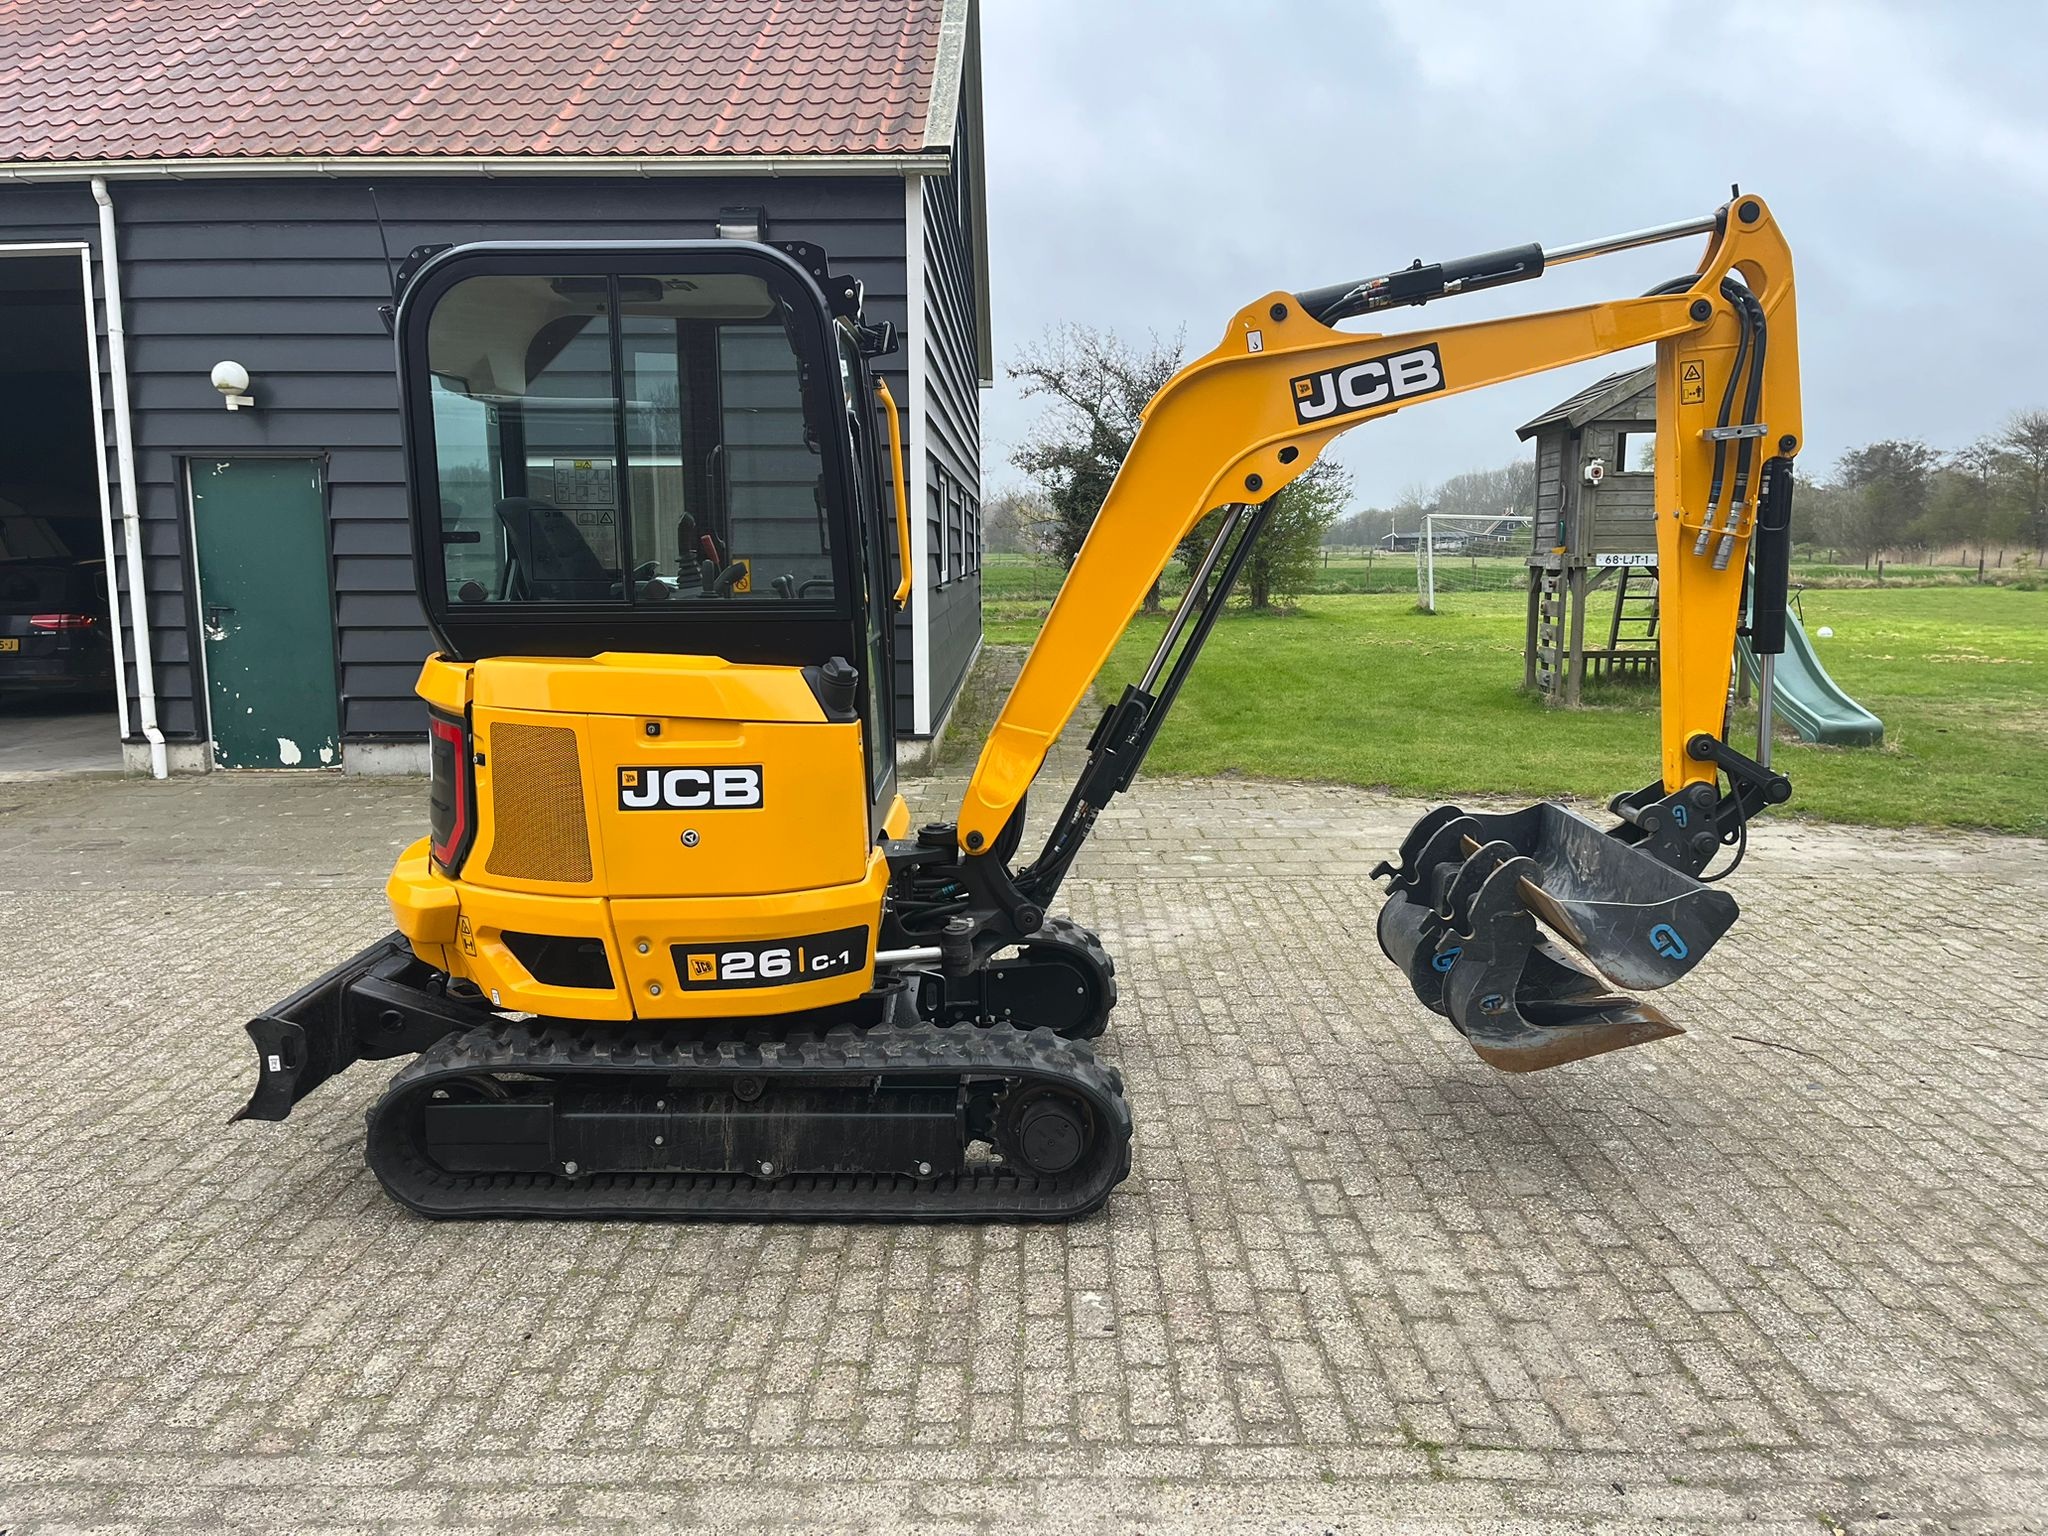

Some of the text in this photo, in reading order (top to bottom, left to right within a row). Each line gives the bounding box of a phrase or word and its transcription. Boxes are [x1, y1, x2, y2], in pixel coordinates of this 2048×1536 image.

[1298, 349, 1440, 419] JCB
[1605, 555, 1649, 565] 68-LJT-1
[622, 769, 760, 807] JCB
[721, 948, 792, 980] 26
[811, 950, 849, 971] C-1
